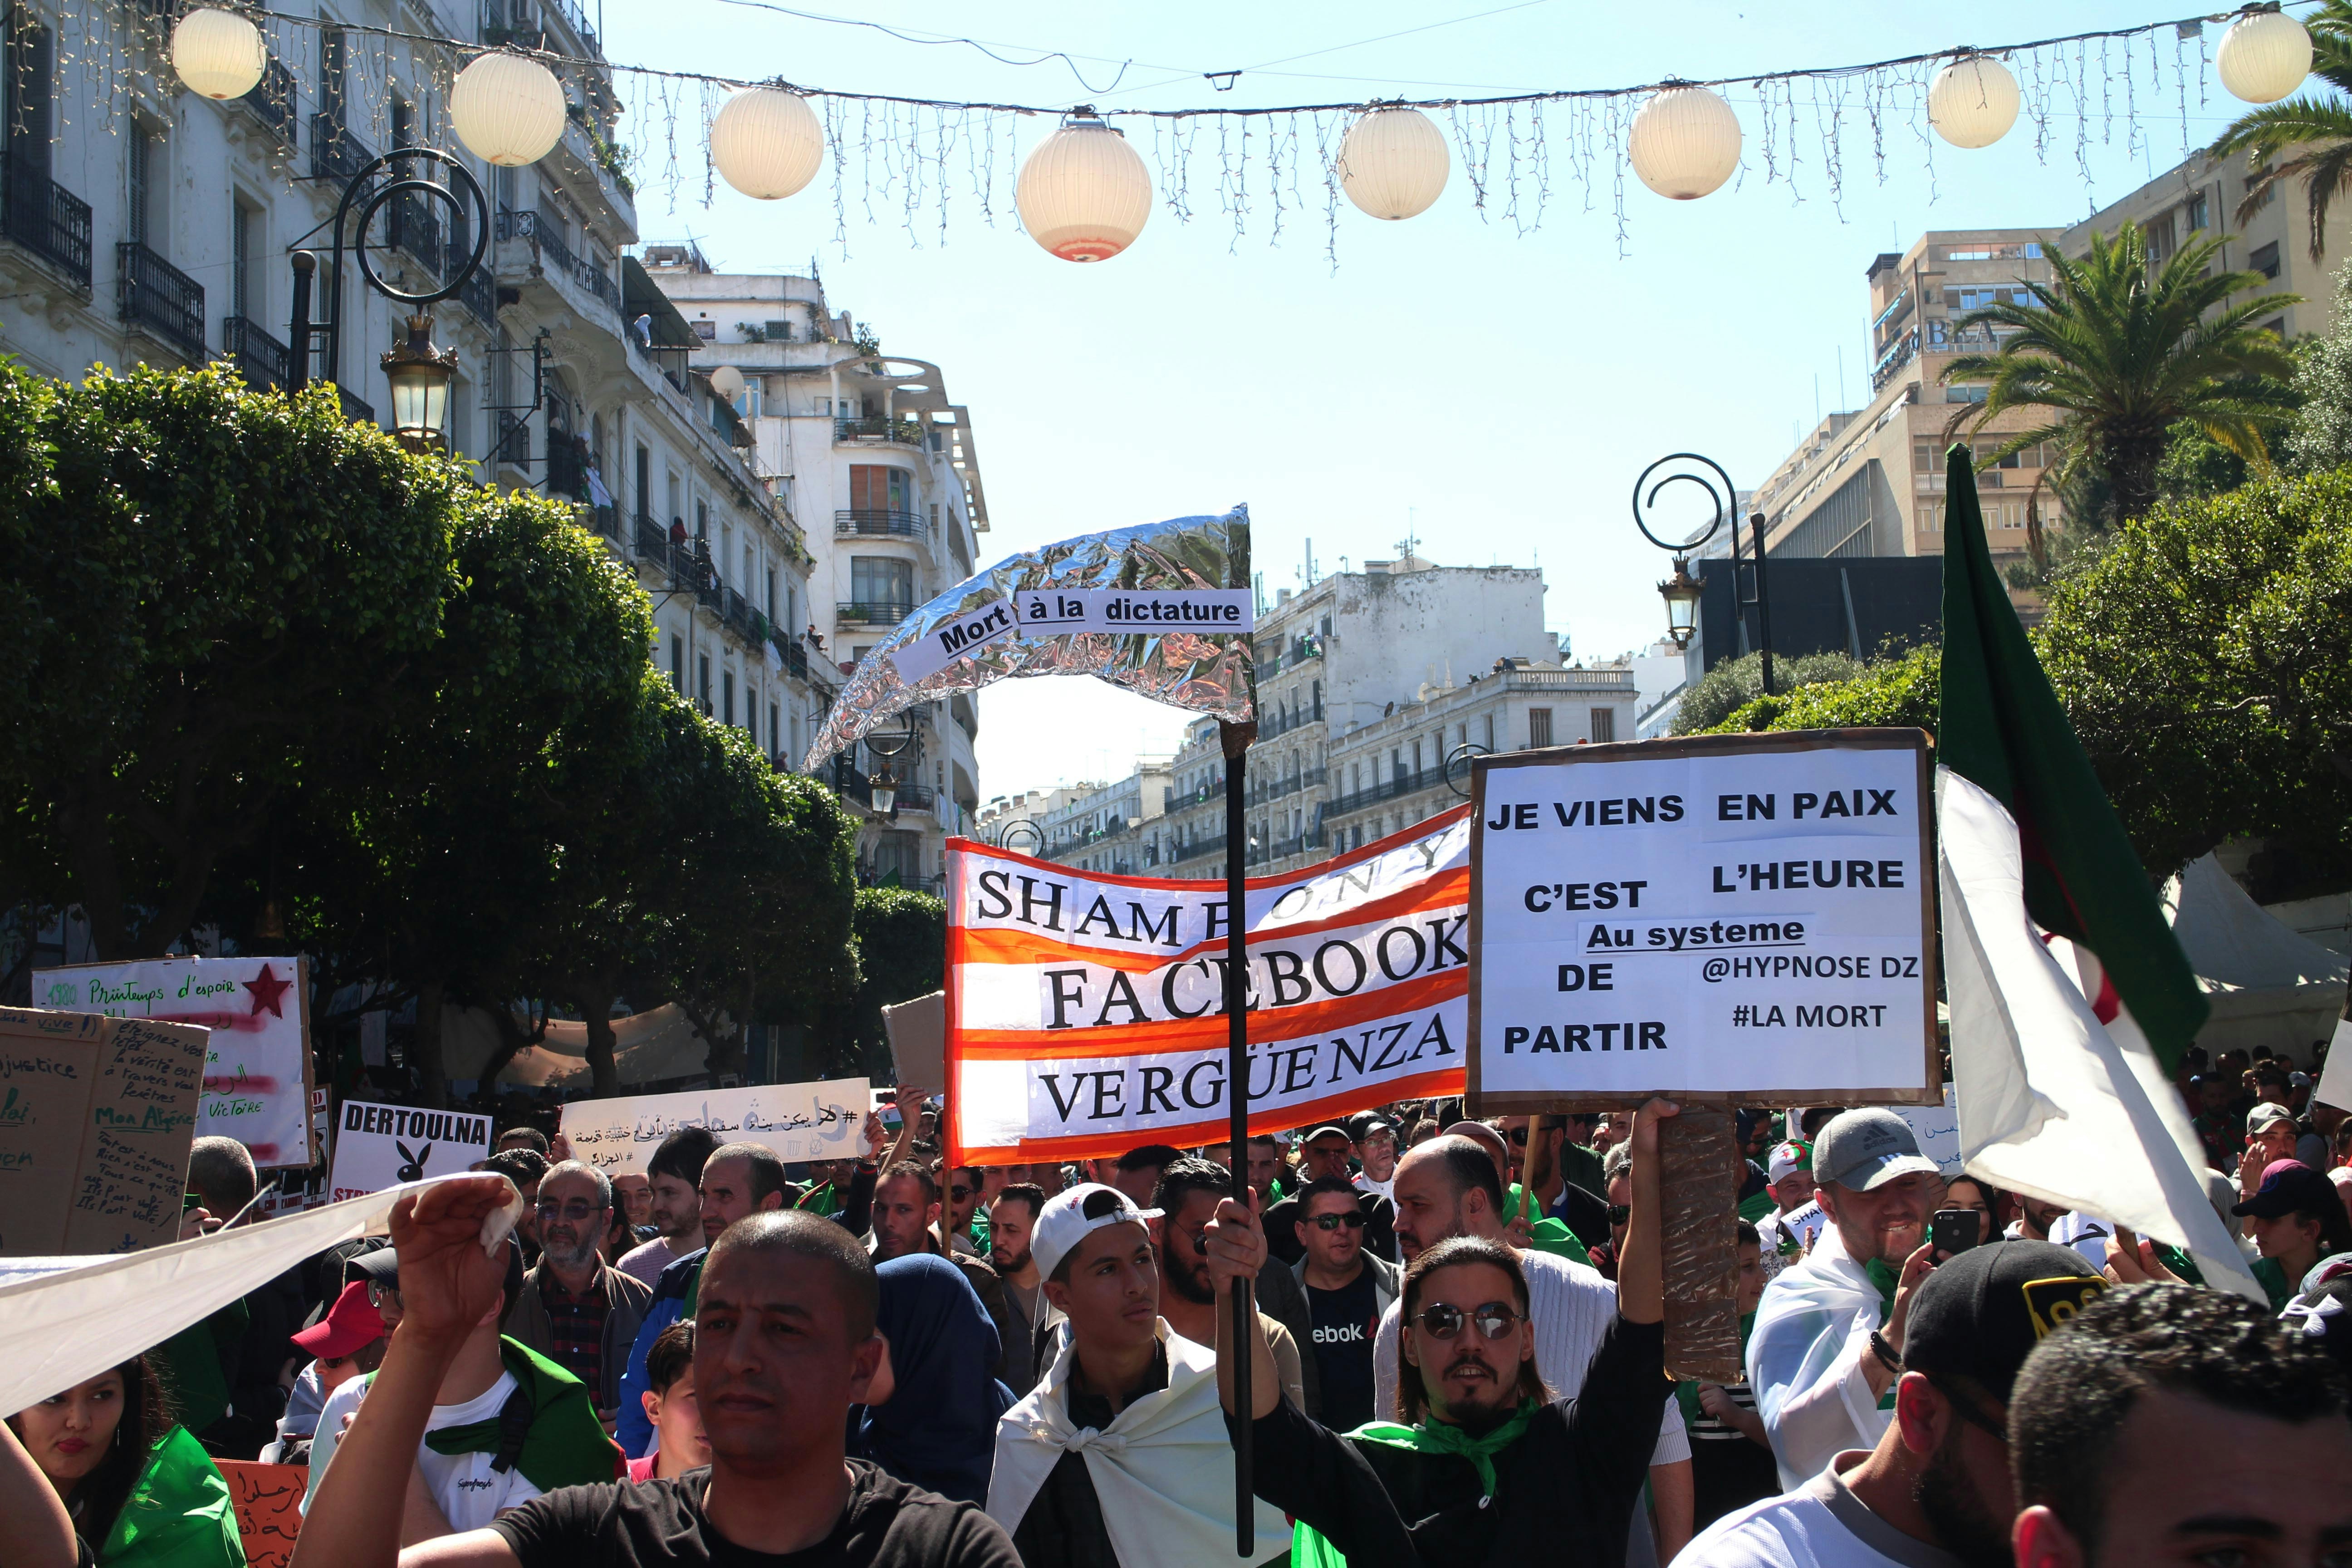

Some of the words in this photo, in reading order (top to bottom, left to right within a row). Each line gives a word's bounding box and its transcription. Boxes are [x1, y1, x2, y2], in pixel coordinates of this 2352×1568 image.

[939, 605, 1010, 654] Mort
[1030, 596, 1047, 618] à
[1059, 595, 1083, 617] la
[1105, 598, 1240, 621] dictature
[1488, 804, 1539, 831] JE
[1553, 795, 1684, 827] VIENS
[1718, 794, 1777, 821] EN
[1793, 789, 1897, 819] PAIX
[1271, 856, 1382, 920] ON
[1586, 924, 1634, 948] Au
[1647, 920, 1804, 951] systeme
[1044, 914, 1468, 1030] FACEBOOK
[1558, 964, 1614, 992] DE
[1702, 956, 1871, 983] @HYPNOSE
[1882, 956, 1918, 978] DZ
[48, 984, 78, 1006] 1980
[1733, 1005, 1786, 1028] #LA
[1796, 1004, 1887, 1028] MORT
[1504, 1022, 1666, 1054] PARTIR
[1039, 1012, 1455, 1123] VERGÜENZA
[95, 1107, 136, 1125] Mon
[344, 1104, 486, 1146] DERTOULNA
[1864, 1137, 1897, 1150] adidas
[458, 1478, 493, 1492] Superfresh
